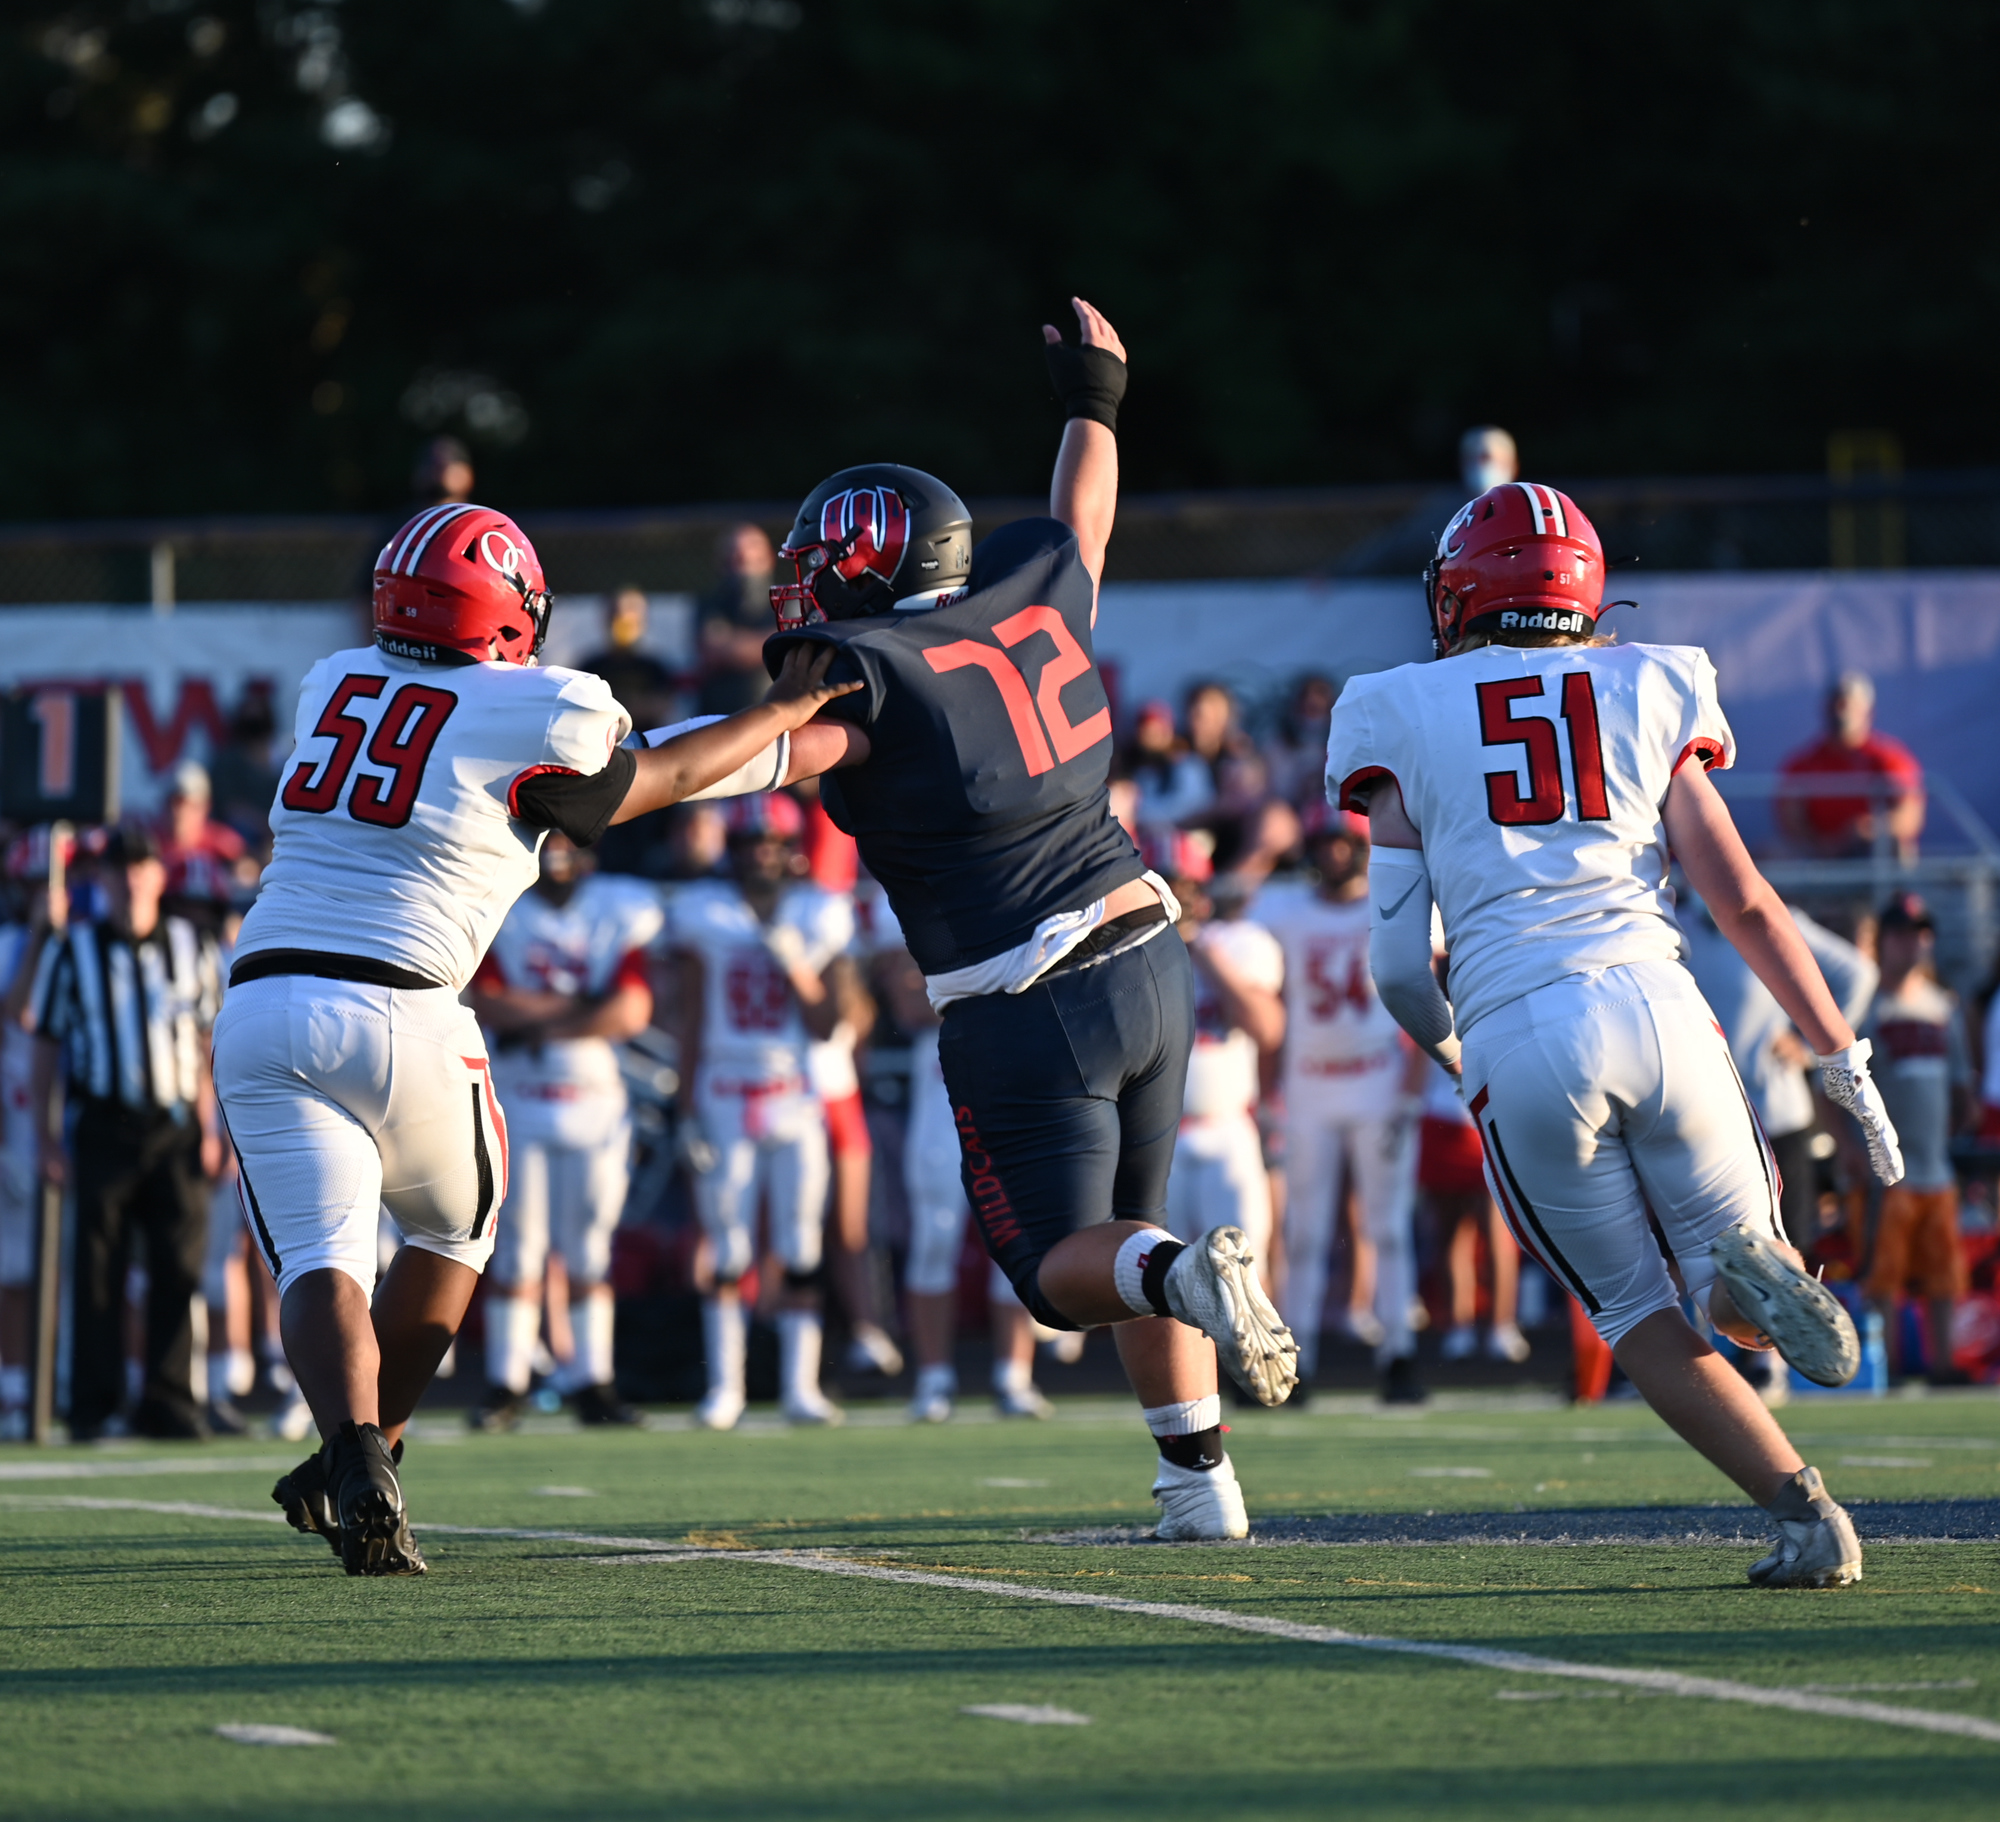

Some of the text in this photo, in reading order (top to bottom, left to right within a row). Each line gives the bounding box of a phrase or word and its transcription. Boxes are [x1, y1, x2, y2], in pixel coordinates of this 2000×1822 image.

[405, 606, 417, 617] 59
[1500, 611, 1583, 633] Riddell
[1559, 573, 1571, 584] 51
[921, 605, 1112, 778] 72
[282, 673, 458, 829] 59
[1475, 671, 1611, 827] 51
